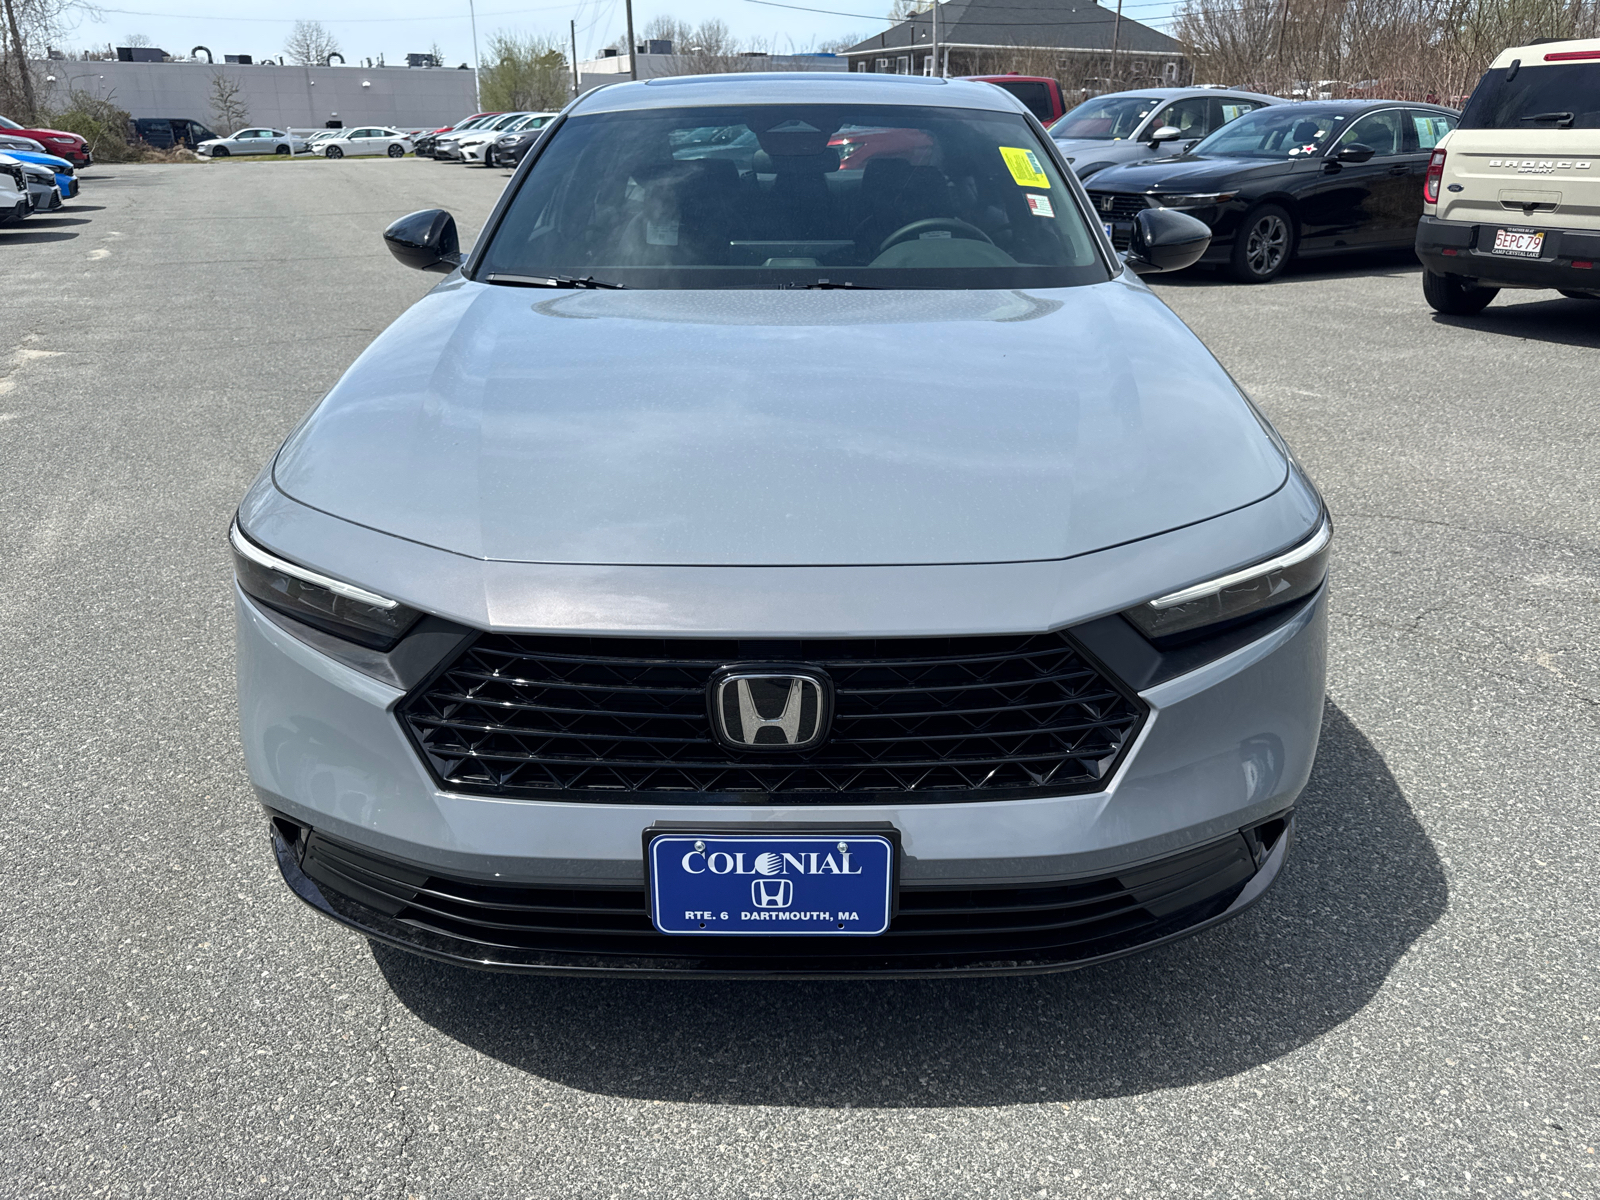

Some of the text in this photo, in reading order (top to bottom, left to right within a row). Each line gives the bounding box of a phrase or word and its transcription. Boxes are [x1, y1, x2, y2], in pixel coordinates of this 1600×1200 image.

[1489, 160, 1591, 169] BRONCO
[1495, 233, 1541, 250] 5EPC 79
[681, 851, 862, 876] COLONIAL
[685, 910, 859, 922] RTE. 6 DARTMOUTH, MA
